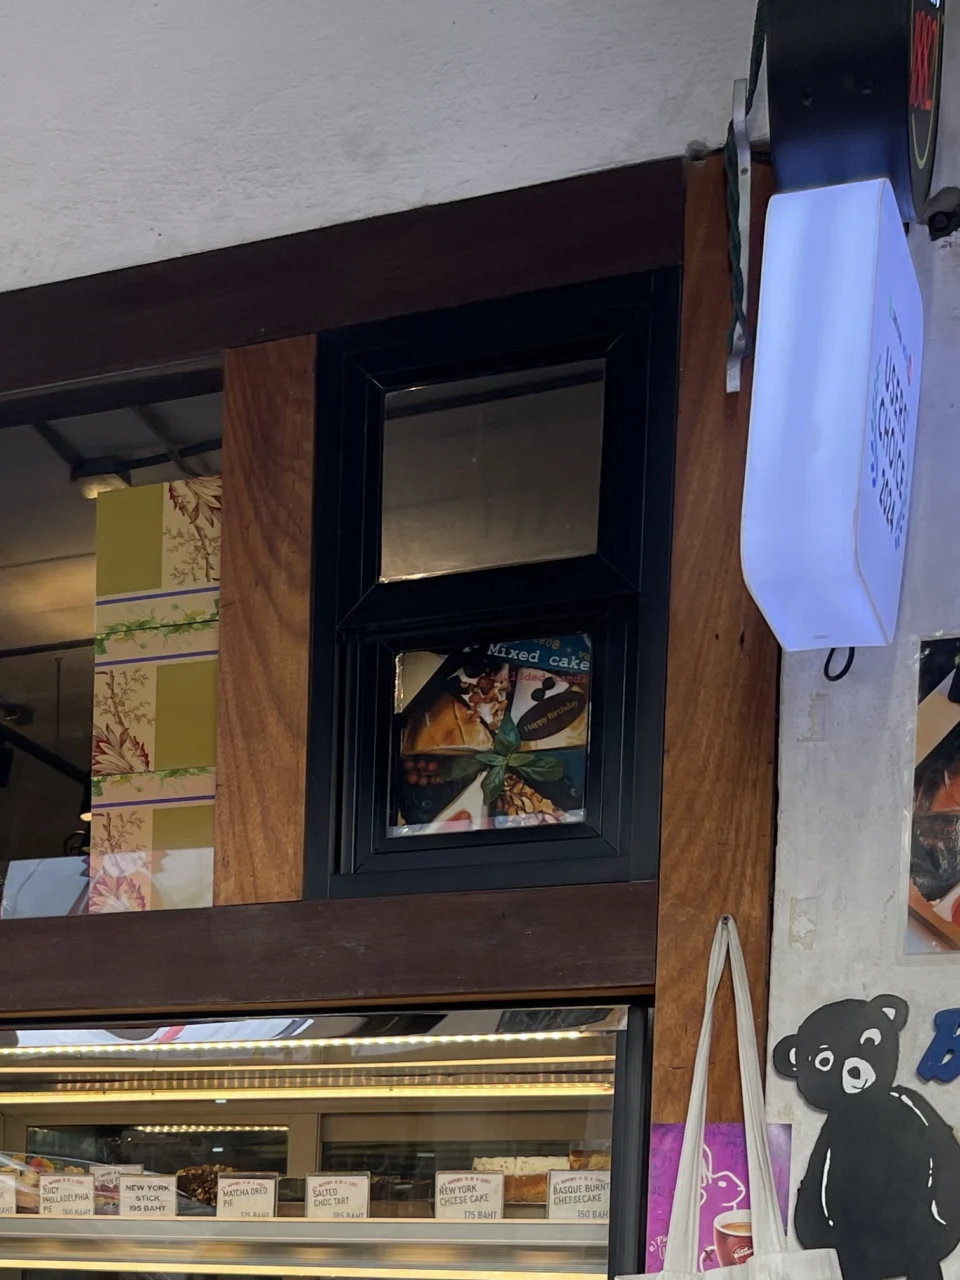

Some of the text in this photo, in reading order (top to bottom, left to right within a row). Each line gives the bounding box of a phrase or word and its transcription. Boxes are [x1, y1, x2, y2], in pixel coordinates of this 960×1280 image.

[878, 396, 905, 501] CHOICE
[879, 468, 895, 535] 2024
[487, 643, 540, 663] Mixed
[549, 656, 590, 671] cake
[524, 700, 580, 732] Happy Birthday
[42, 1186, 59, 1195] JUICY
[147, 1184, 171, 1192] YORK
[223, 1187, 268, 1198] MATCHA OREO
[313, 1188, 338, 1198] SALTED
[439, 1185, 477, 1196] NEW YORK
[553, 1182, 610, 1195] BASQUE BURNT
[223, 1199, 234, 1208] PIE
[314, 1197, 349, 1207] CHOC TART
[440, 1194, 489, 1207] CHEESE CAKE
[553, 1194, 602, 1206] CHEESECAKE
[43, 1205, 53, 1213] PIE
[578, 1210, 608, 1218] 150 BAH
[464, 1211, 497, 1219] 175 BAHT
